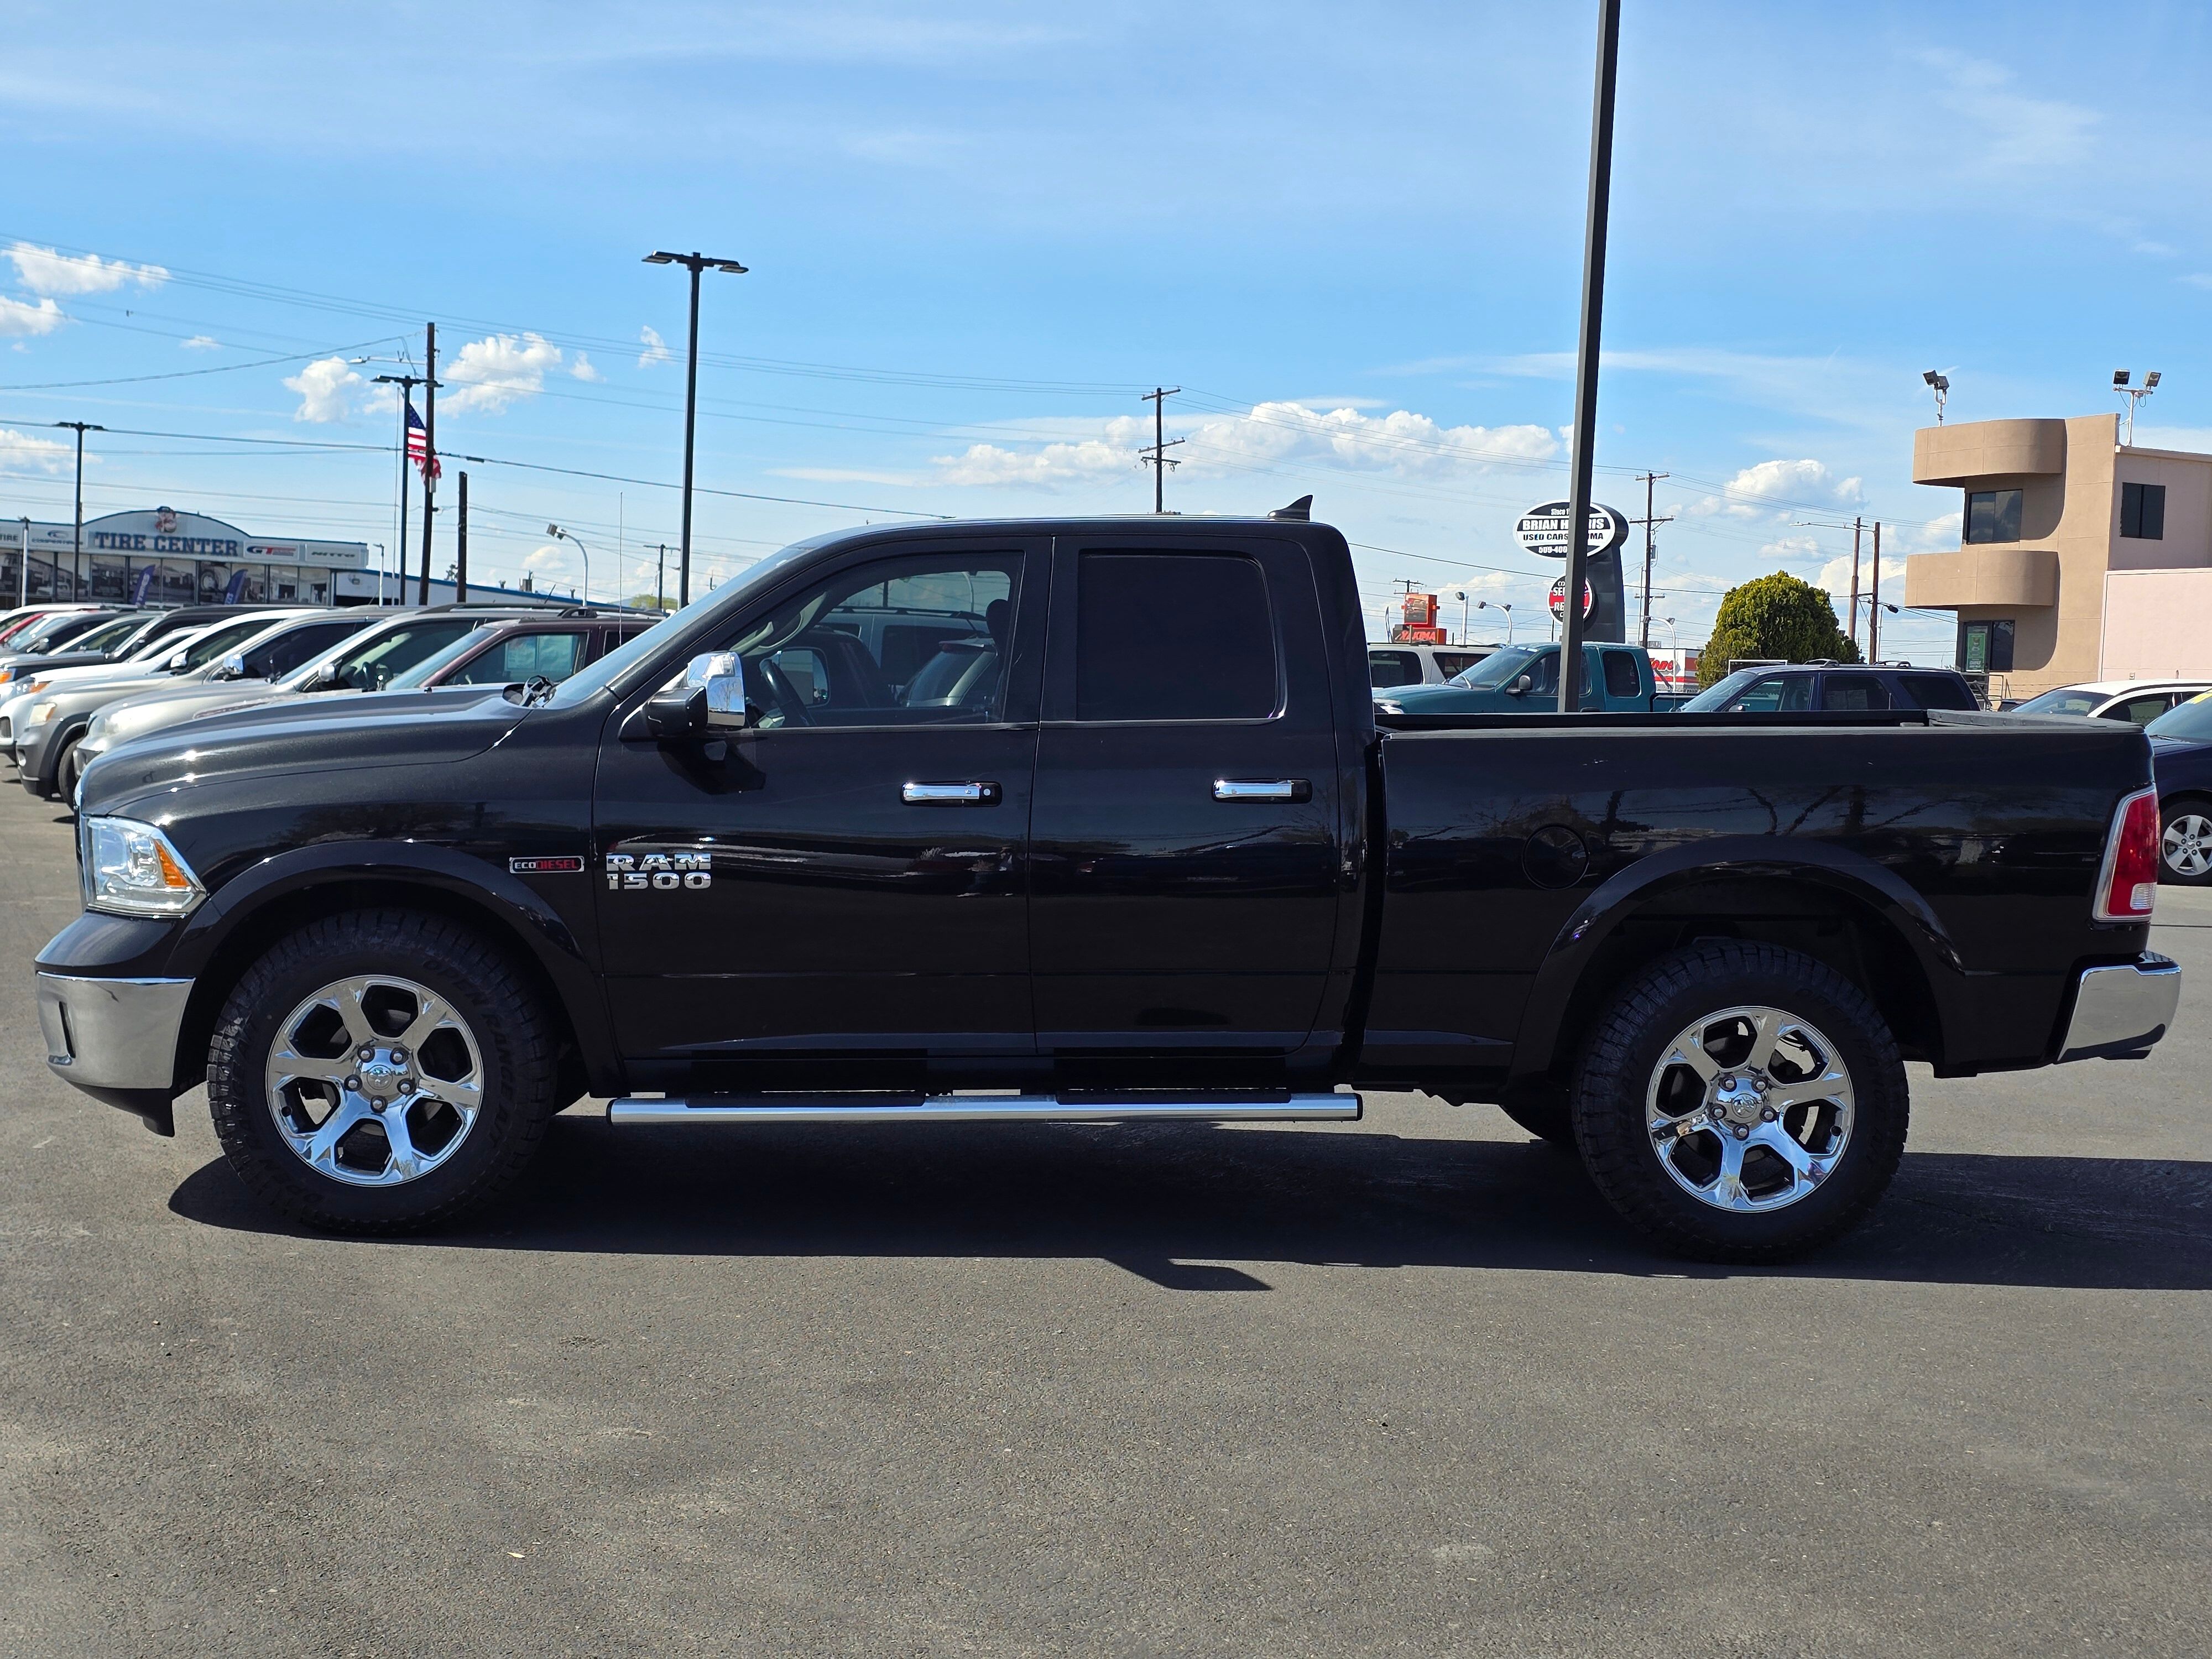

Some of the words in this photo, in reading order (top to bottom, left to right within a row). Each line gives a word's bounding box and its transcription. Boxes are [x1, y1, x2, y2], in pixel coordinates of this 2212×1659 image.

[1522, 519, 1558, 530] BRIAN
[95, 532, 147, 551] TIRE
[154, 535, 238, 556] CENTER
[514, 859, 578, 870] ECODIESEL
[606, 853, 712, 871] RAM
[607, 872, 712, 890] 1500
